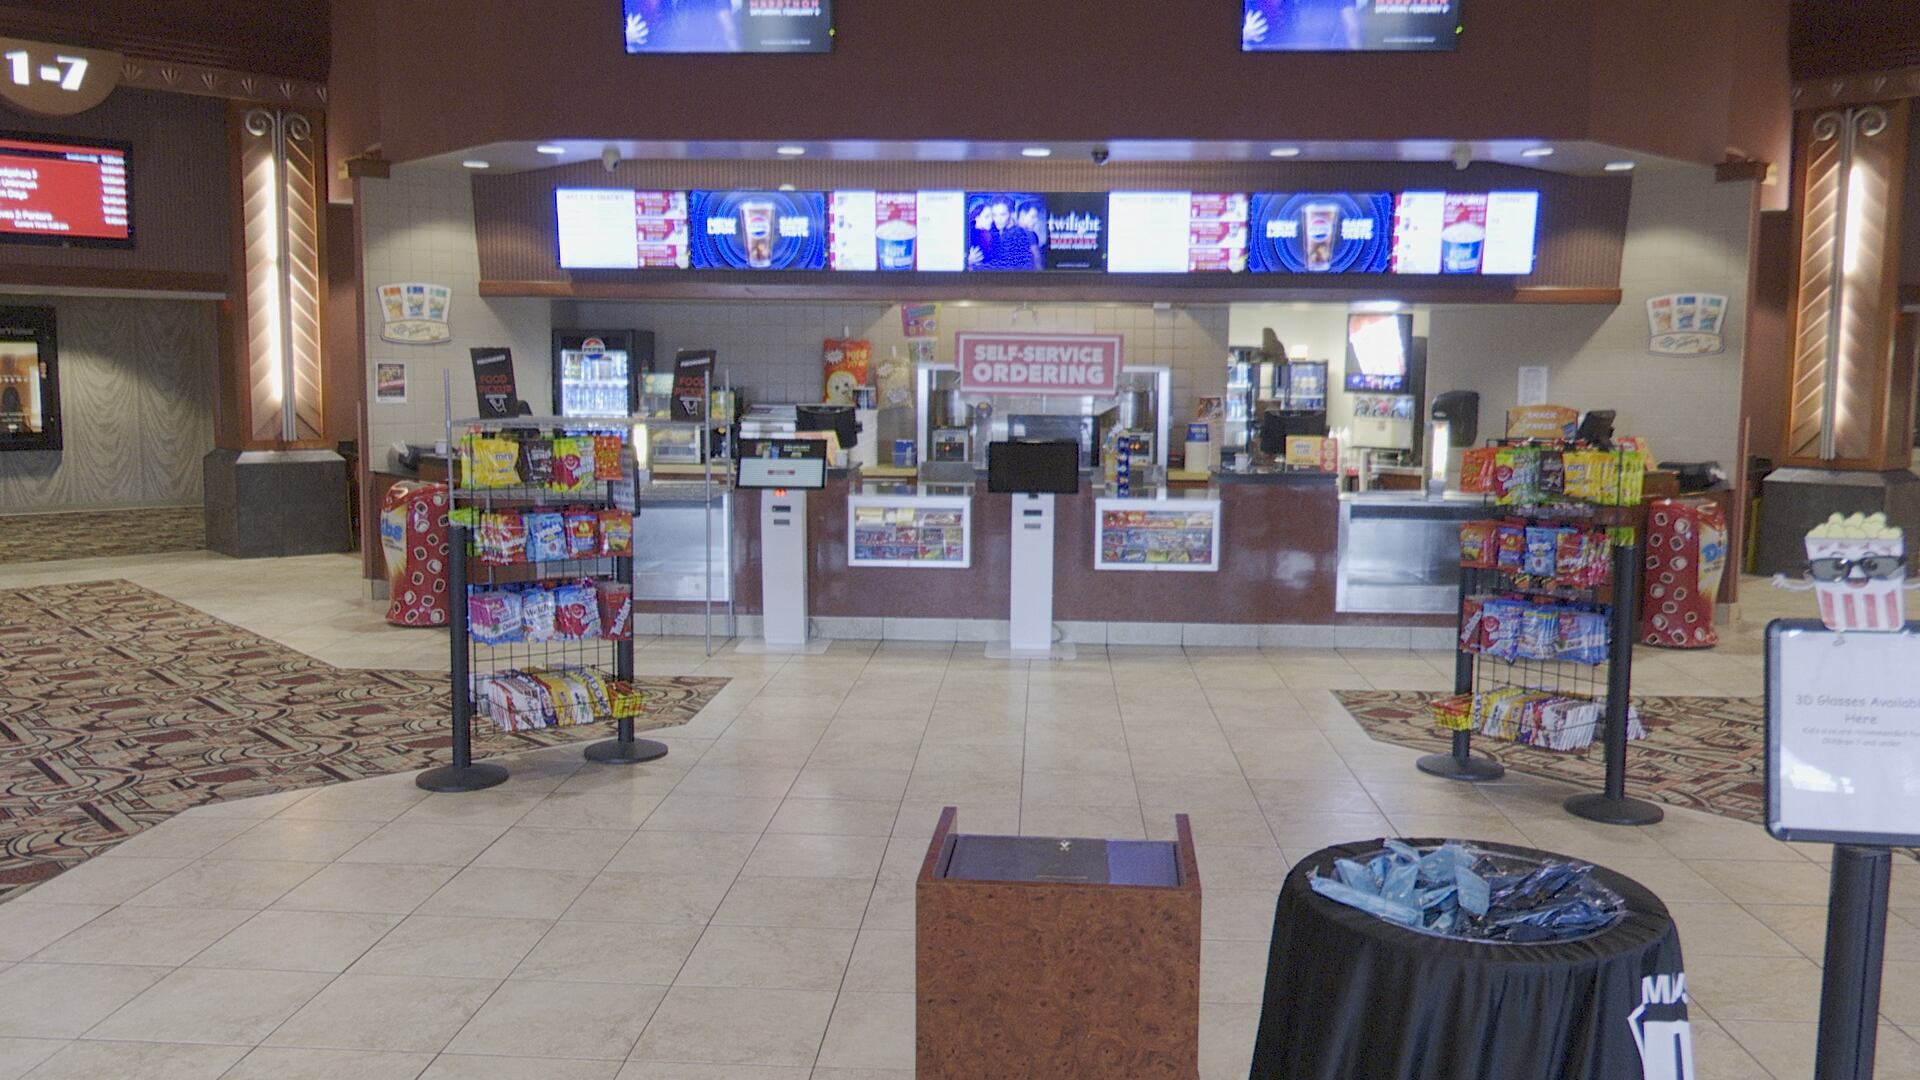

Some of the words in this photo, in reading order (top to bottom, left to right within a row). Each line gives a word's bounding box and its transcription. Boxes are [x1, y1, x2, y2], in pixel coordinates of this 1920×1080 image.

[1048, 210, 1101, 236] twilight
[974, 344, 1104, 363] SELF-SERVICE
[479, 374, 508, 384] FOOD
[972, 362, 1104, 385] ORDERING
[1795, 694, 1813, 706] 3D
[1817, 694, 1866, 707] Glasses
[1870, 696, 1920, 709] Availab
[1844, 713, 1879, 725] Here
